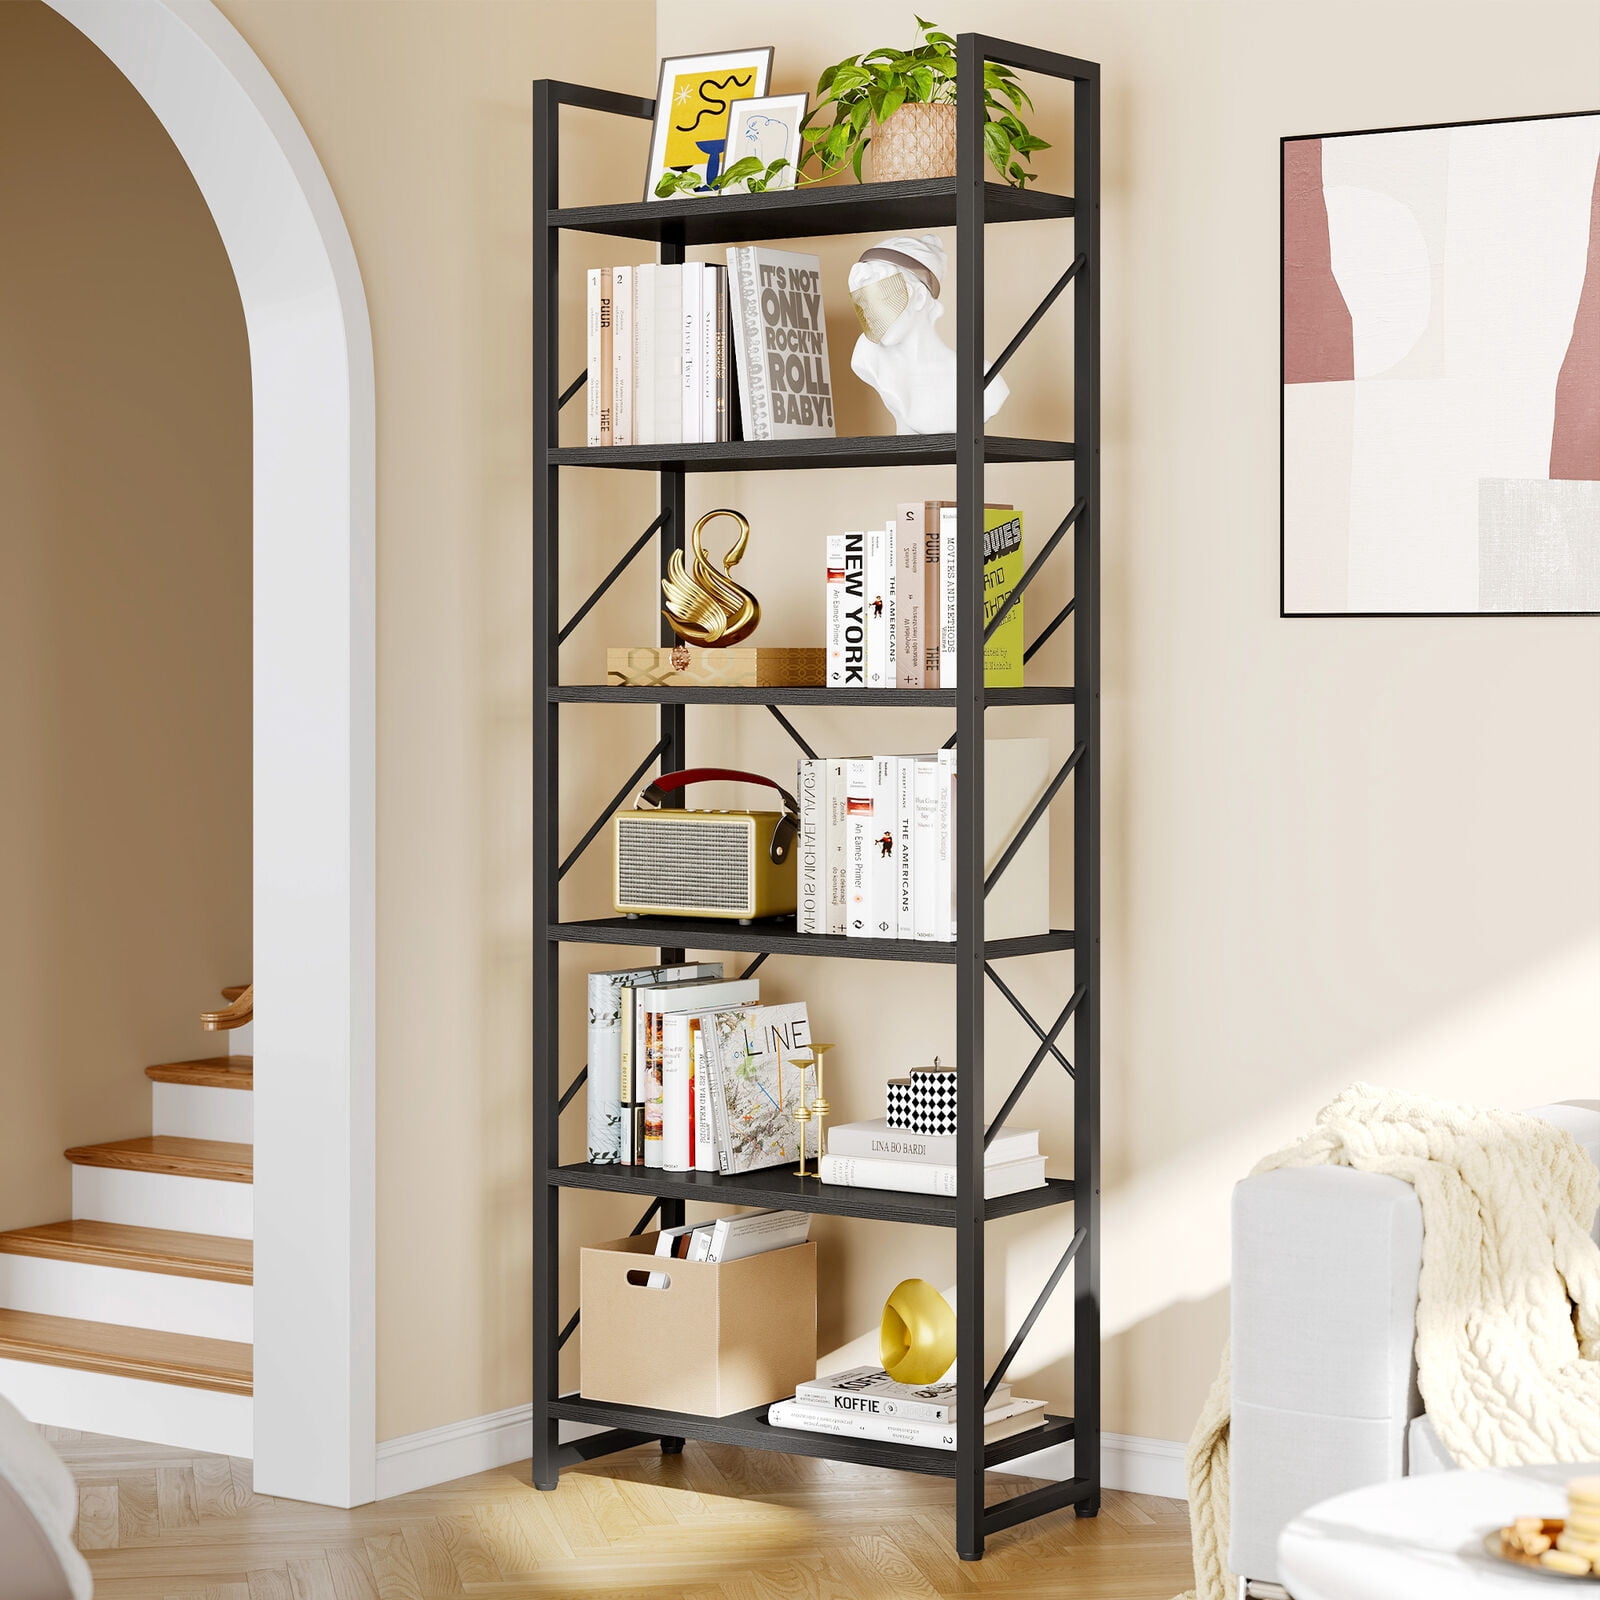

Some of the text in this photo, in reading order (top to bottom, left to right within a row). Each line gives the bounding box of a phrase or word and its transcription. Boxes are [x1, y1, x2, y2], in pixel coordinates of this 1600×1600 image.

[617, 275, 623, 284] 2
[759, 264, 819, 293] IT'S NOT
[761, 288, 821, 331] ONLY
[765, 326, 824, 355] ROCK'N'
[600, 298, 610, 432] PUUR THEE
[768, 352, 830, 396] ROLL
[772, 392, 833, 428] BABY!
[984, 518, 1022, 563] OVIES
[833, 589, 840, 599] An
[845, 534, 863, 684] NEW YORK
[925, 532, 940, 671] PUUR THEE
[947, 537, 955, 653] MOVIES AND METHODS
[835, 766, 841, 776] 1
[854, 823, 863, 889] An Eames Primer
[743, 1020, 808, 1057] LINE
[871, 1139, 926, 1156] LINA BO BARDI
[834, 1395, 880, 1413] KOFFIE
[943, 1436, 953, 1444] 2
